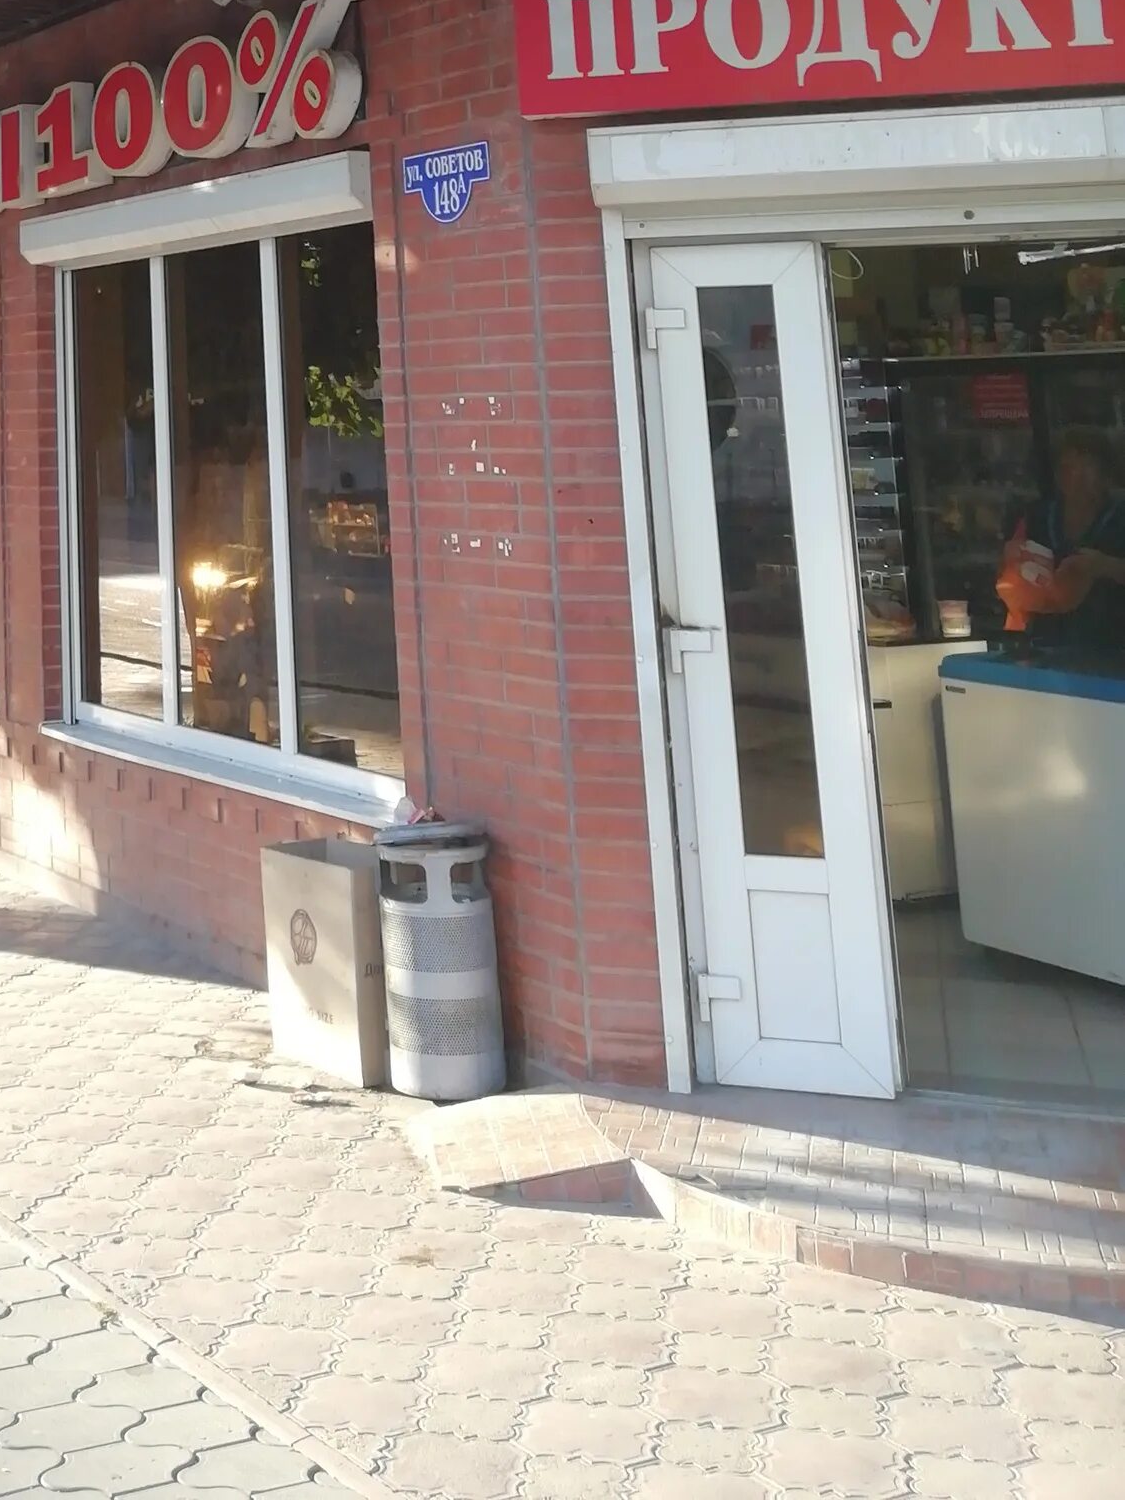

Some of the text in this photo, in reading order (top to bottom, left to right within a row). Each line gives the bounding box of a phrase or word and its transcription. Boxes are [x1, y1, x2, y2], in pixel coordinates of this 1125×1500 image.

[406, 149, 484, 188] ул. СОВЕТОВ
[433, 173, 467, 215] 148А
